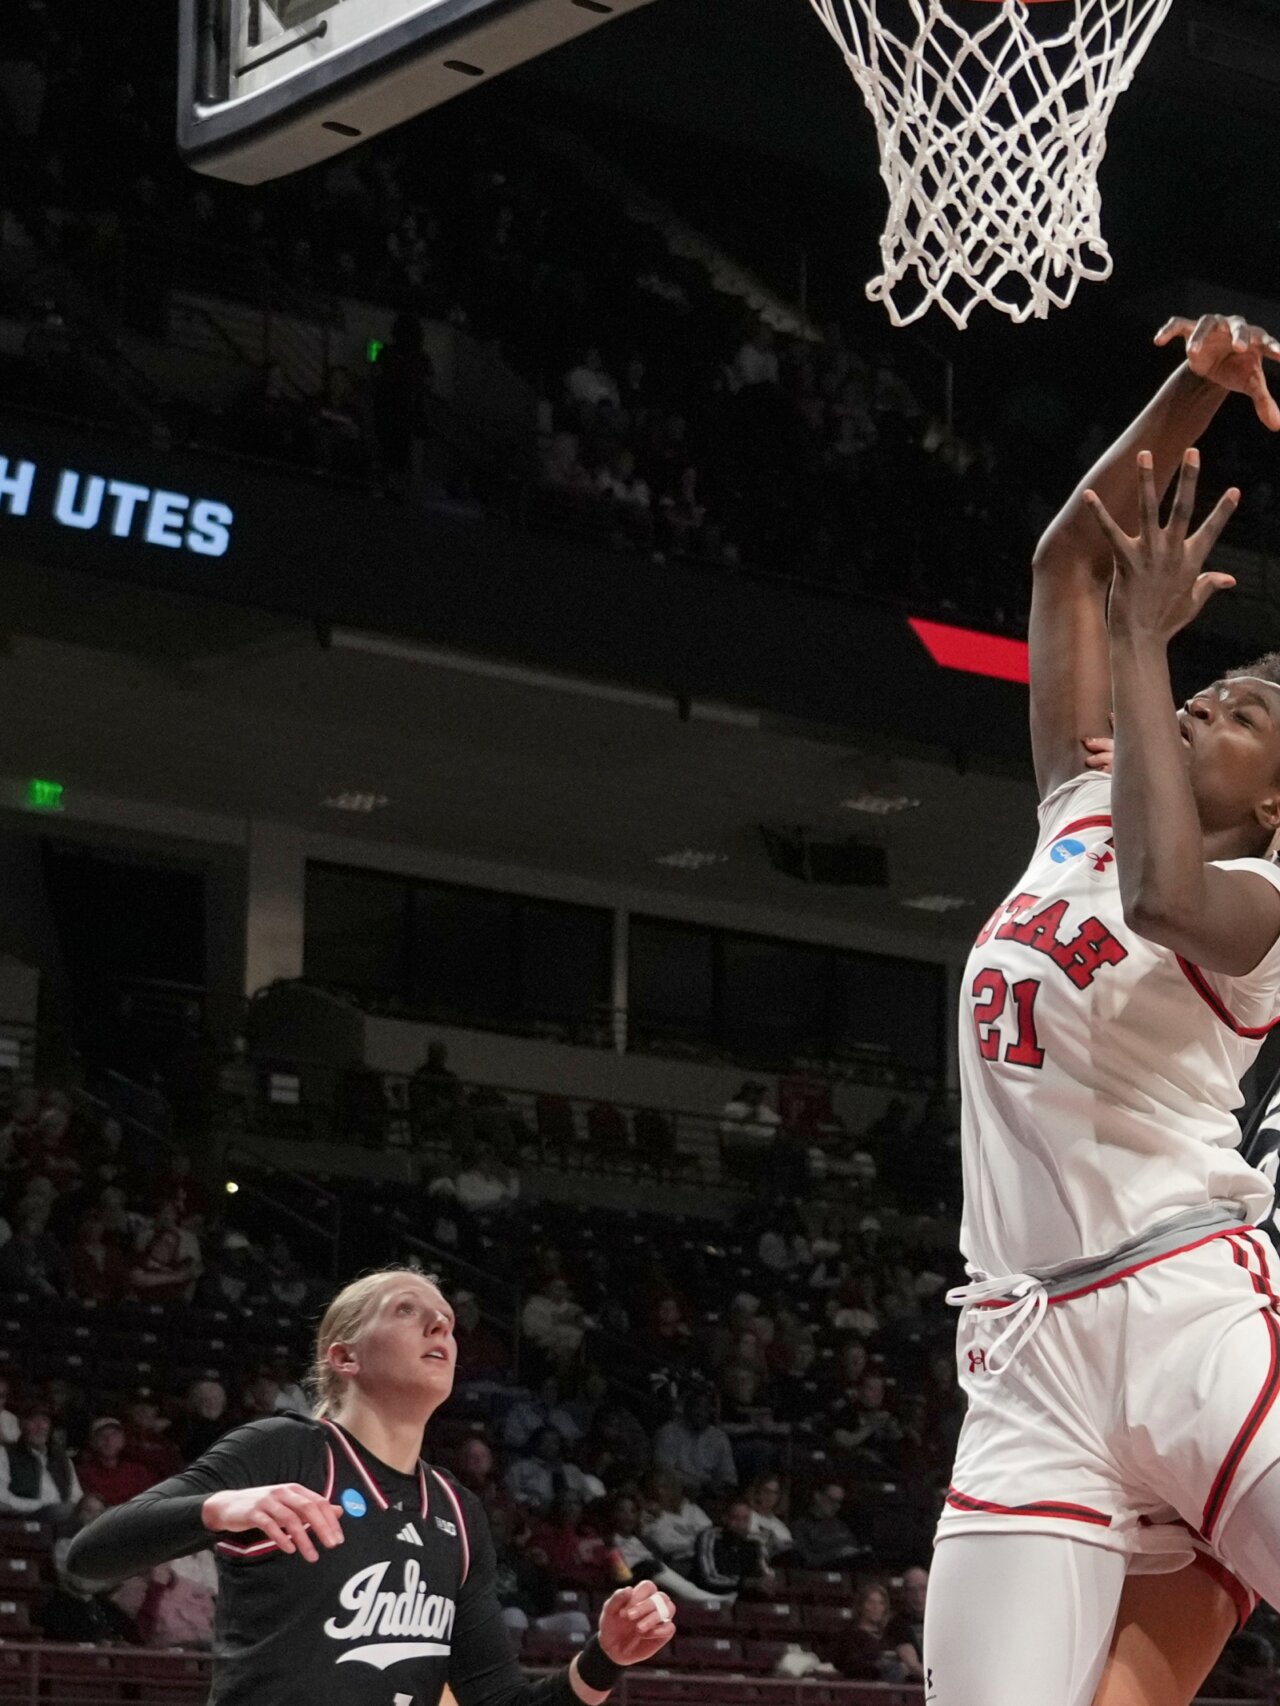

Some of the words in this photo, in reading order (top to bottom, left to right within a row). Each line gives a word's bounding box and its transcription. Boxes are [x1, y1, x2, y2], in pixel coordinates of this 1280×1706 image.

[0, 455, 37, 516] H
[54, 468, 234, 557] UTES
[975, 892, 1129, 990] UTAH
[972, 968, 1045, 1069] 21
